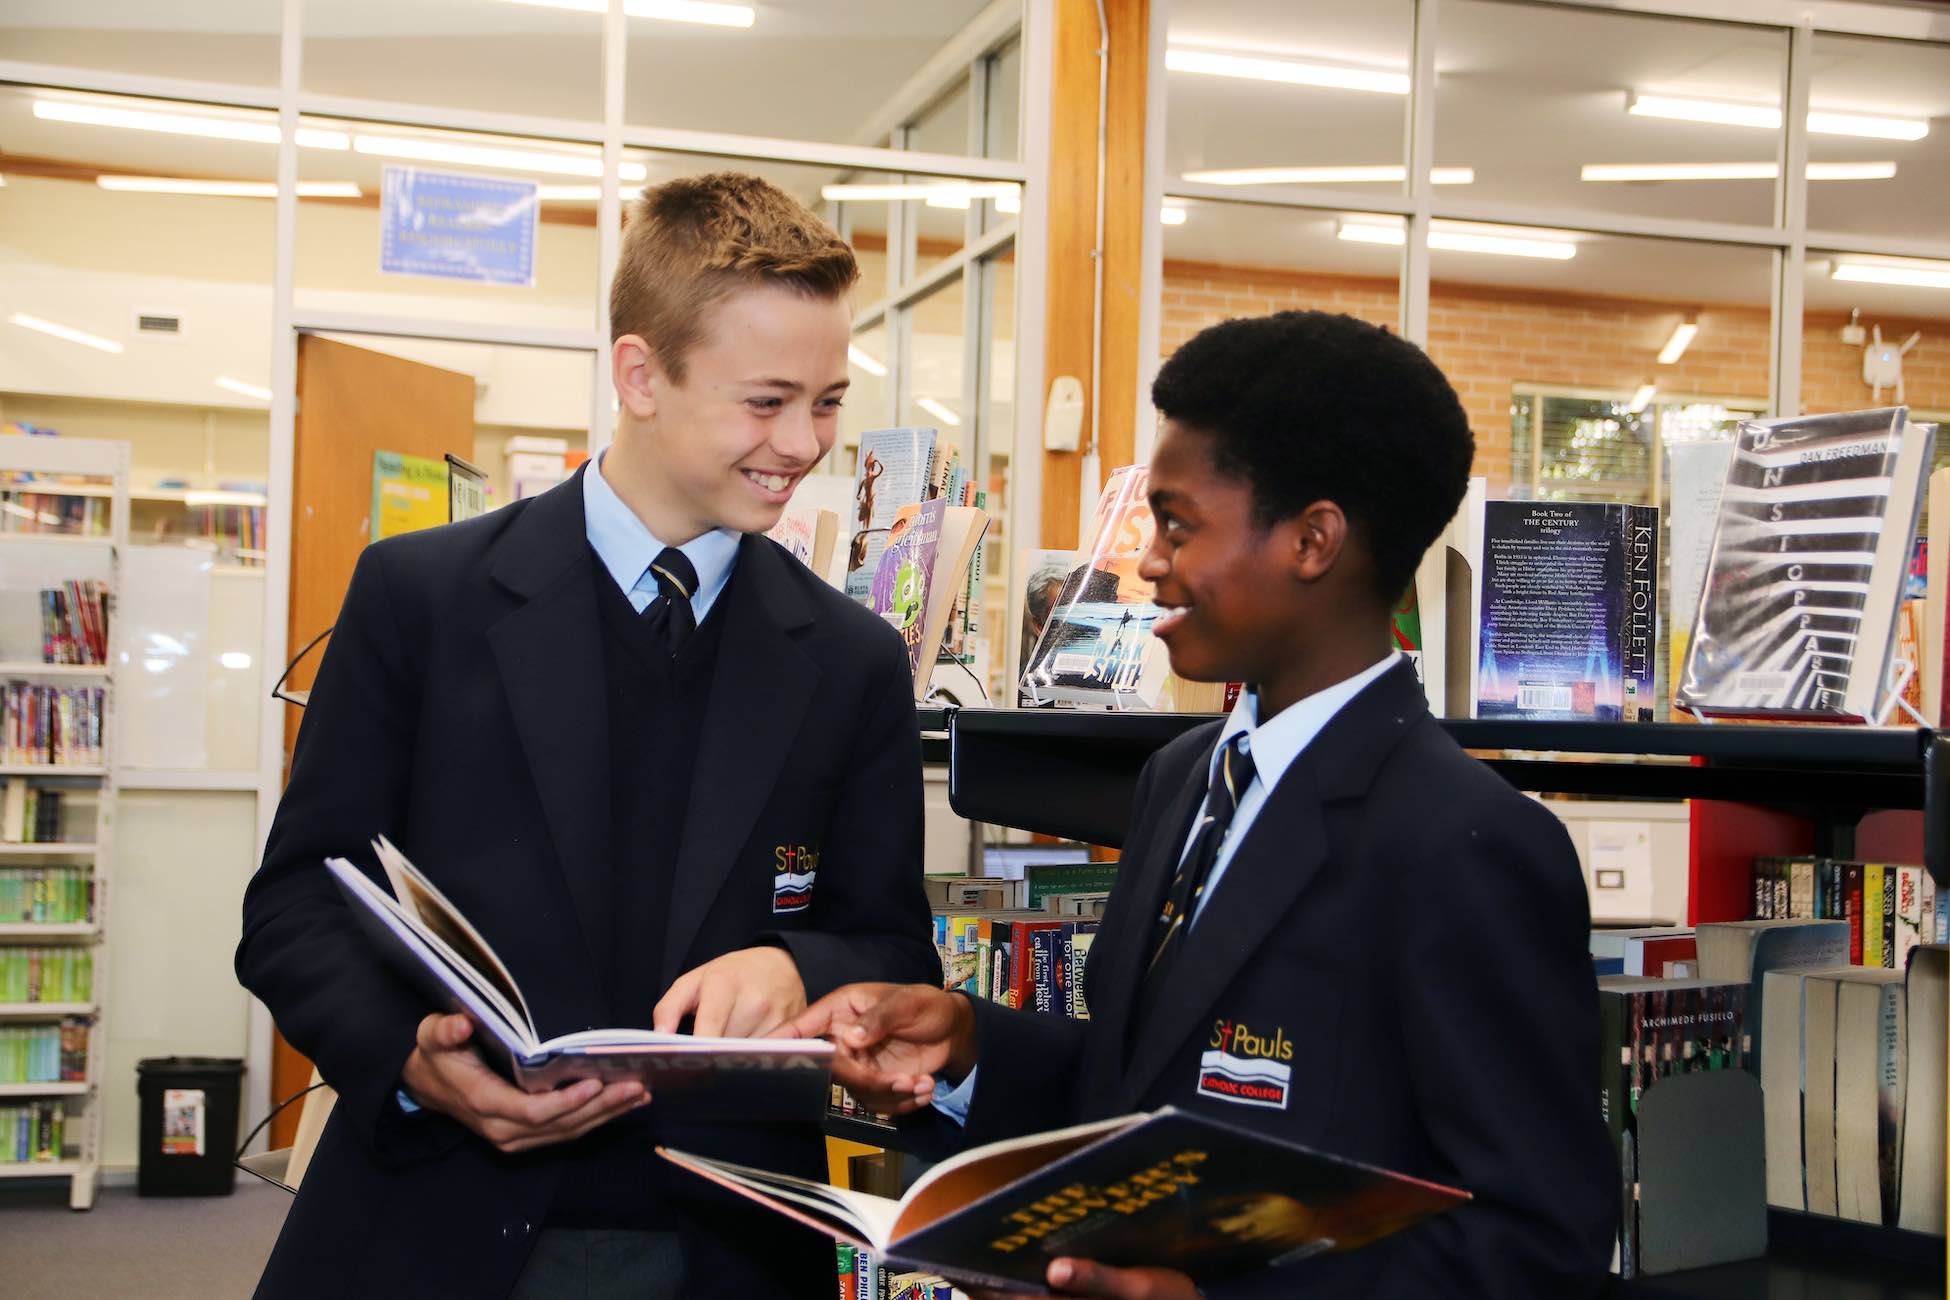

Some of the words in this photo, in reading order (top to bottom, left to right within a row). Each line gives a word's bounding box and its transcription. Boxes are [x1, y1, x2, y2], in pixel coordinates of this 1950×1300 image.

[1800, 450, 1822, 464] DAN
[1826, 441, 1888, 460] FREEDMAN
[940, 461, 951, 493] FINAL
[1540, 528, 1561, 536] trilogy
[1633, 525, 1652, 572] KEN
[1632, 578, 1650, 681] FOLLETT
[1034, 936, 1044, 957] call
[1063, 940, 1073, 961] for
[1034, 958, 1043, 980] from
[1041, 965, 1050, 983] first
[1064, 962, 1072, 988] one
[1073, 948, 1087, 1007] Between
[1641, 1014, 1695, 1029] ARCHIMEDE
[1697, 1011, 1734, 1024] FUSILLO
[1210, 1018, 1233, 1059] St
[1233, 1023, 1293, 1060] Pauls
[1201, 1077, 1239, 1095] CATHOLIC
[1240, 1084, 1282, 1100] COLLEGE
[859, 1252, 868, 1273] BEN
